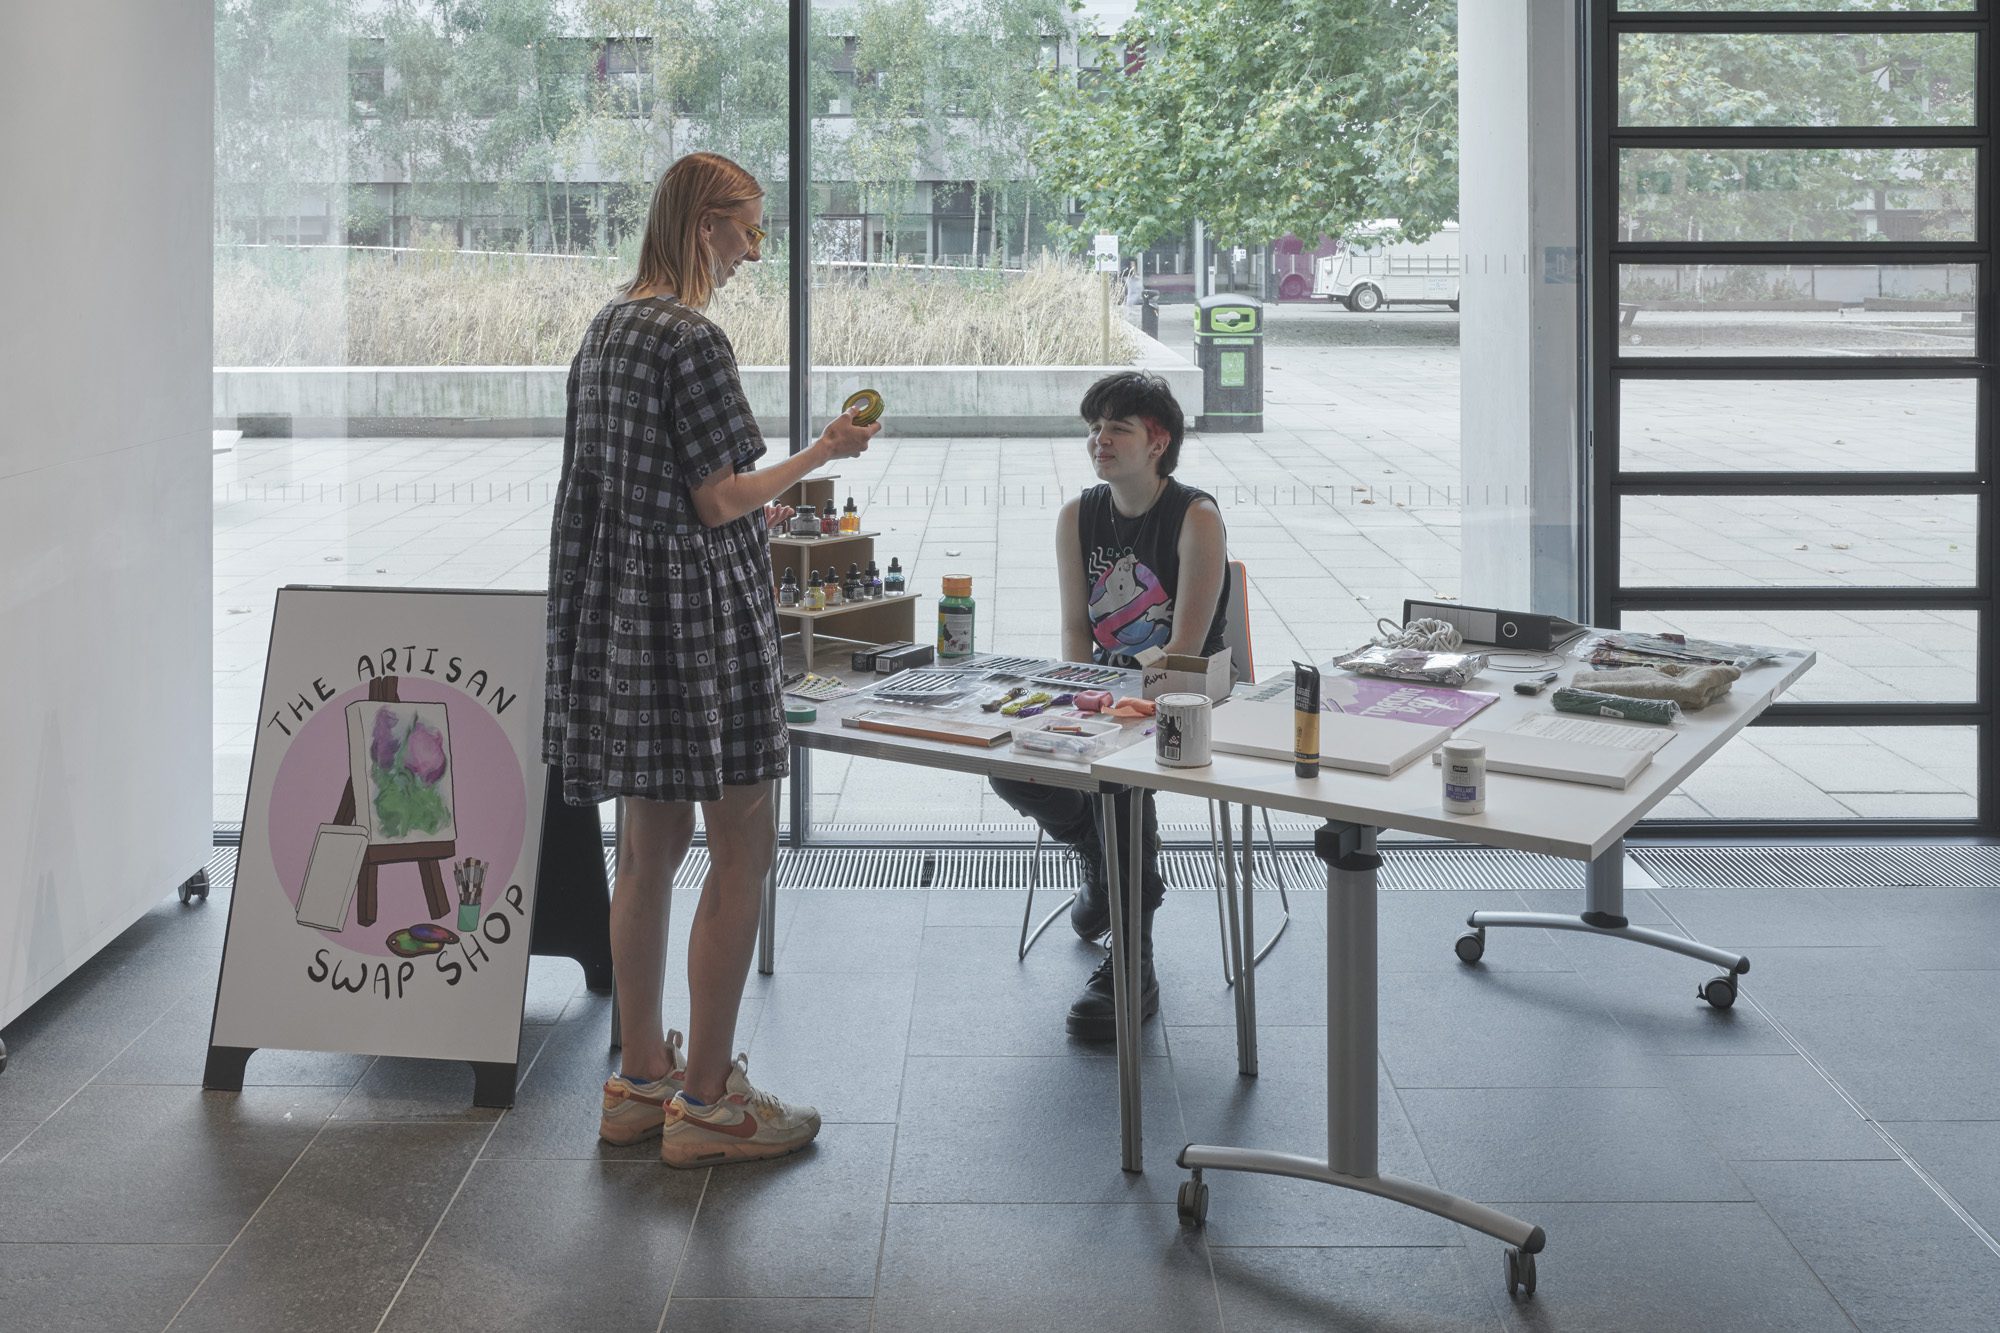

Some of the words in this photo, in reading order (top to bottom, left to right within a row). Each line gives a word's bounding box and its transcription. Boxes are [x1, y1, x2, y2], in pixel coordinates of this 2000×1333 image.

[267, 676, 336, 737] THE
[356, 644, 516, 715] ARTISAN
[1359, 687, 1425, 716] TRACING
[307, 949, 415, 1000] SWAP
[437, 884, 525, 987] SHOP
